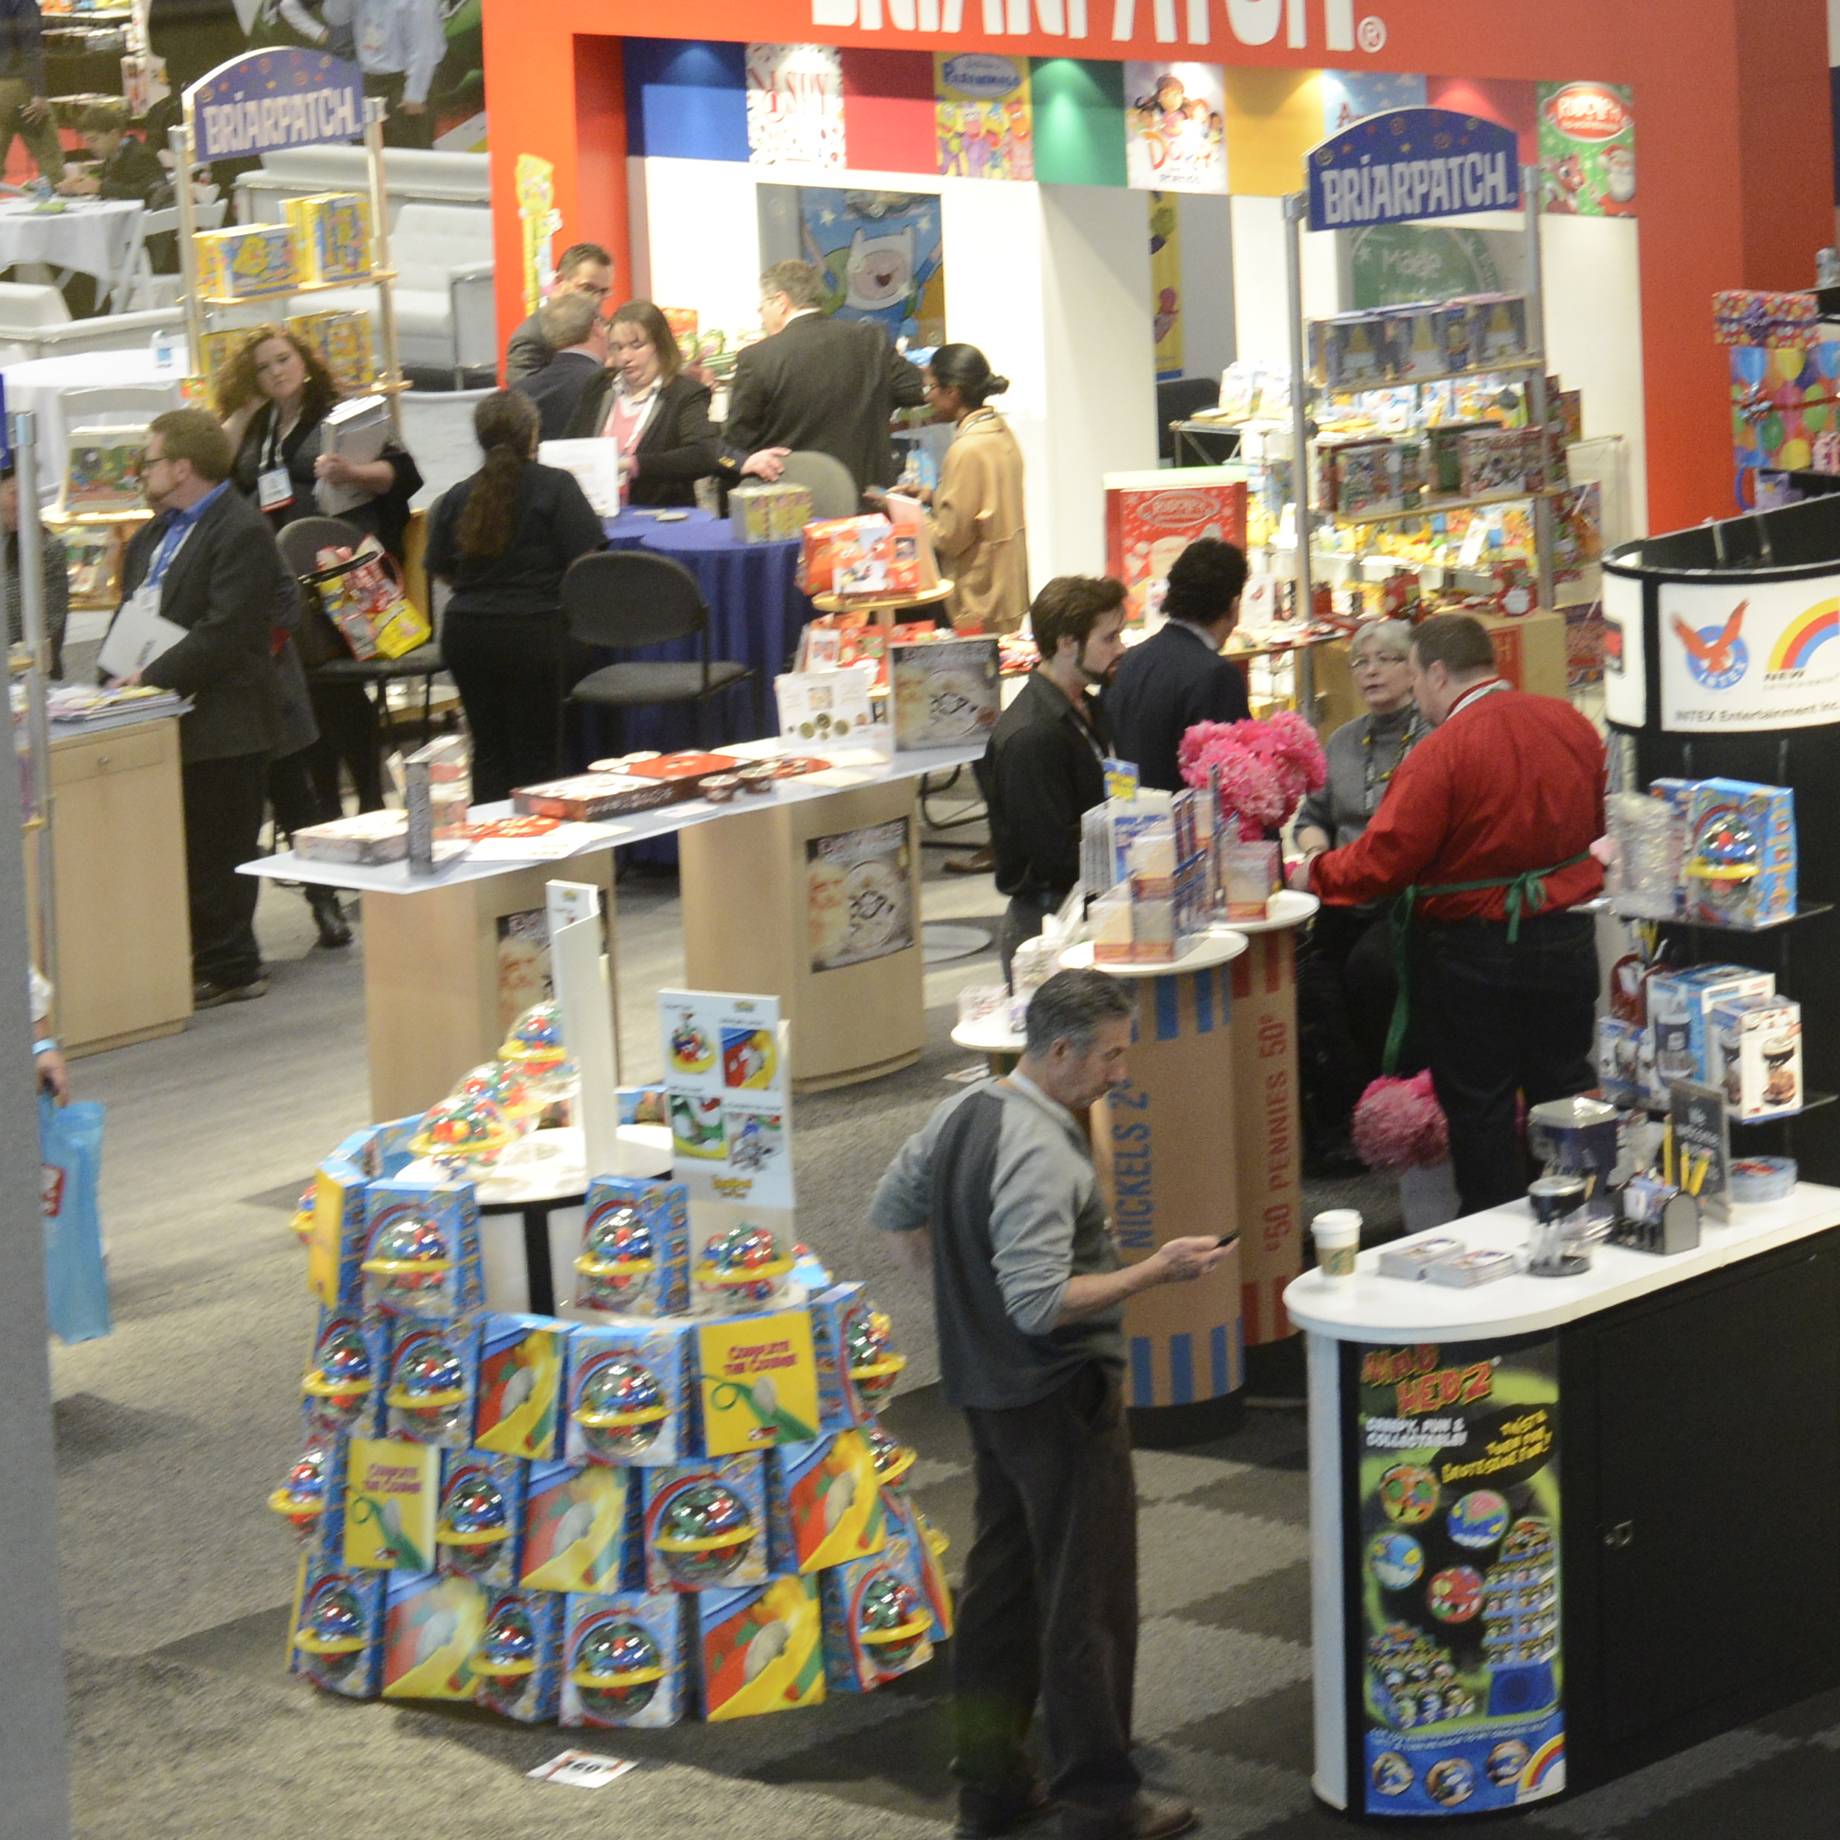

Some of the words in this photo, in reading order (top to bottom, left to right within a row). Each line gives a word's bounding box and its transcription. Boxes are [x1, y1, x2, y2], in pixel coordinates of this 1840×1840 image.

[1674, 708, 1715, 723] INTEX
[1719, 703, 1817, 723] Entertainment
[1265, 1070, 1290, 1193] PENNIES
[1397, 1361, 1493, 1418] HEDZ
